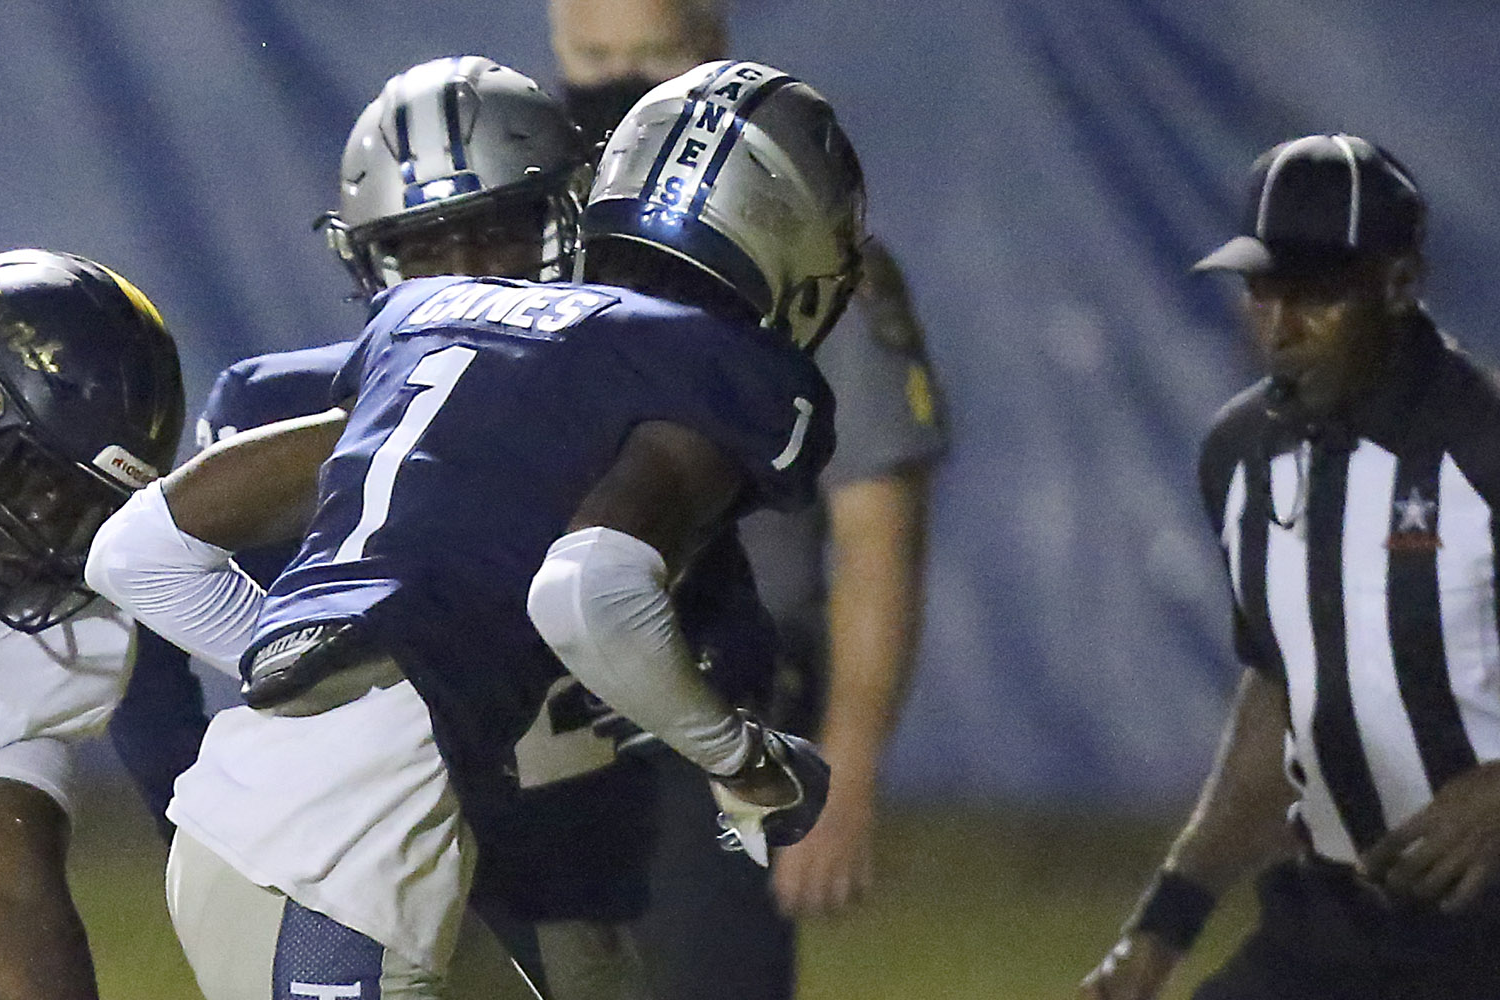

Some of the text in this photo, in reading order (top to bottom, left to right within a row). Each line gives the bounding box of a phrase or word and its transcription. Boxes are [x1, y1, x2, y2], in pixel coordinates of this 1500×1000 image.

[660, 67, 763, 207] CANES
[408, 283, 600, 332] CANES
[331, 345, 478, 563] 1
